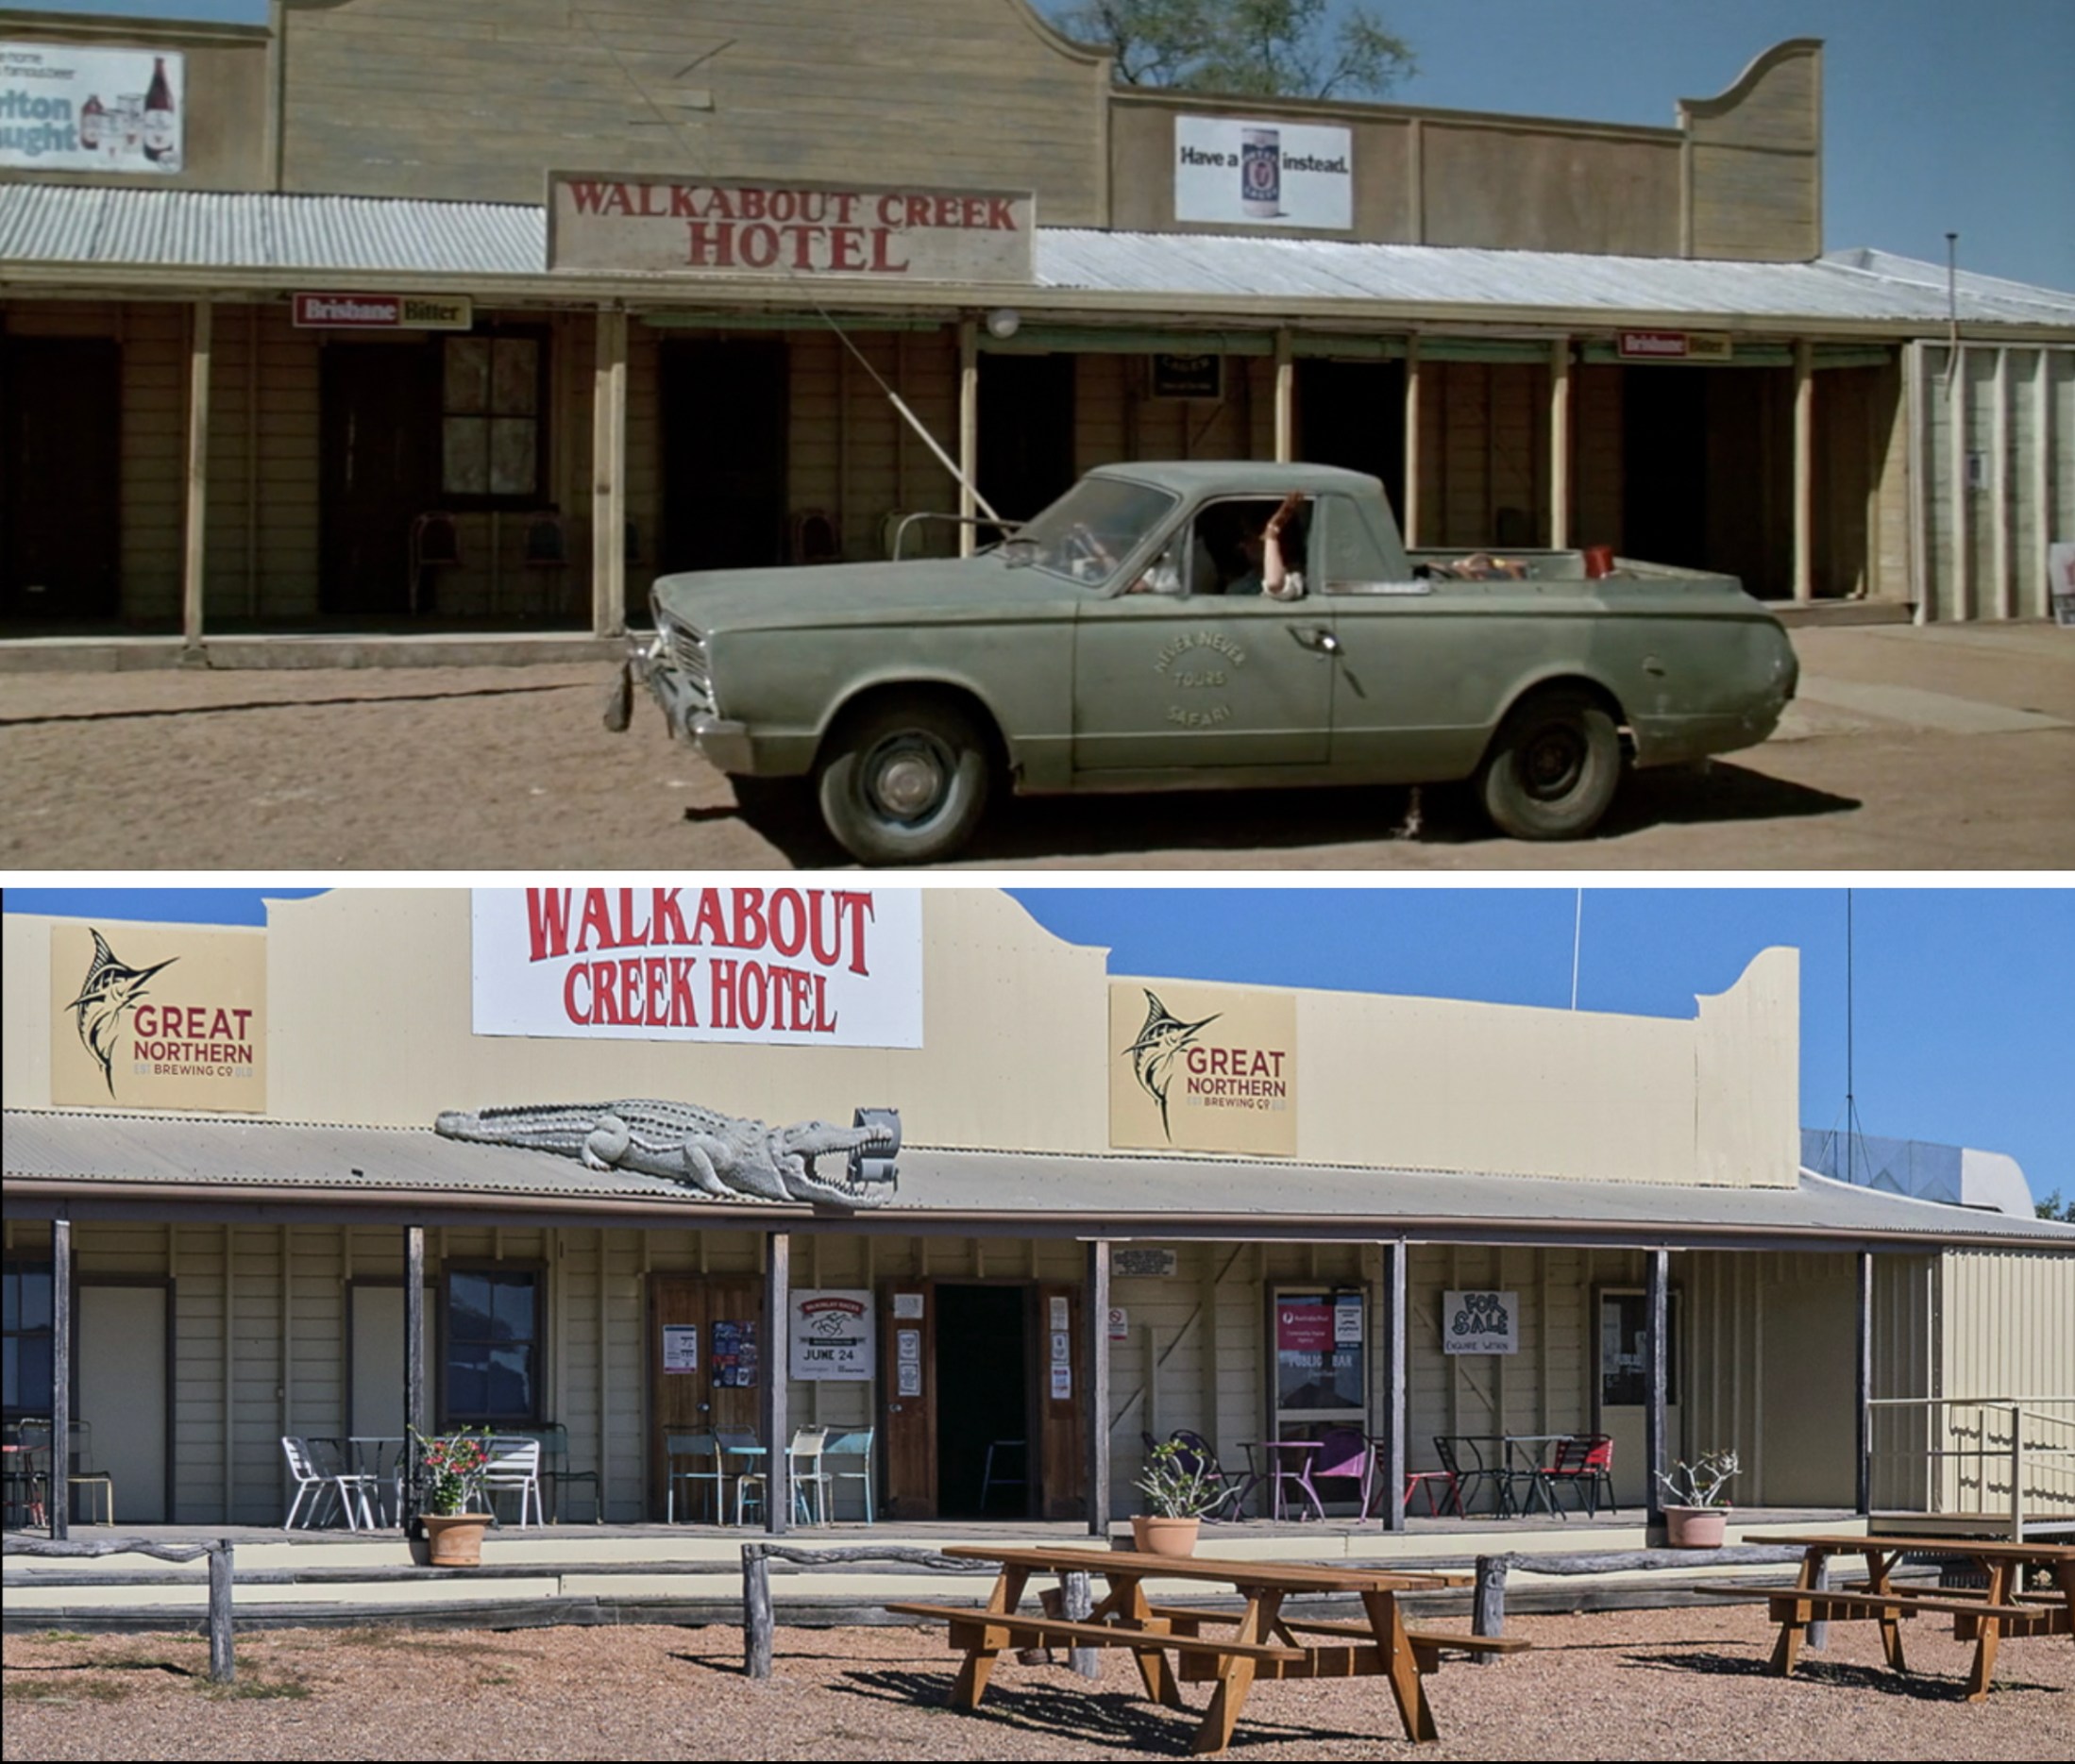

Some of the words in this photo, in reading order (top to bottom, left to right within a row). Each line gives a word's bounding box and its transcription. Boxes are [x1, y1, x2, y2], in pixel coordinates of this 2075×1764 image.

[0, 123, 77, 158] ught
[1180, 146, 1225, 167] Have
[1227, 154, 1239, 167] a
[1283, 153, 1349, 174] instead.
[566, 179, 861, 225] WALKABOUT
[877, 194, 1019, 230] CREEK
[685, 222, 909, 273] HOTEL
[305, 298, 397, 320] Brisbane
[525, 888, 875, 976] WALKABOUT
[565, 955, 699, 1028] CREEK
[709, 958, 838, 1033] HOTEL
[133, 1004, 252, 1040] GREAT
[134, 1040, 252, 1064] NORTHERN
[1187, 1047, 1285, 1078] GREAT
[154, 1064, 214, 1077] BREWING
[1187, 1077, 1286, 1097] NORTHERN
[1204, 1097, 1255, 1110] BREWING
[1463, 1293, 1508, 1315] FOR
[1451, 1310, 1509, 1336] SALE
[803, 1349, 835, 1361] JUNE
[838, 1349, 854, 1361] 24
[1332, 1354, 1353, 1368] BAR
